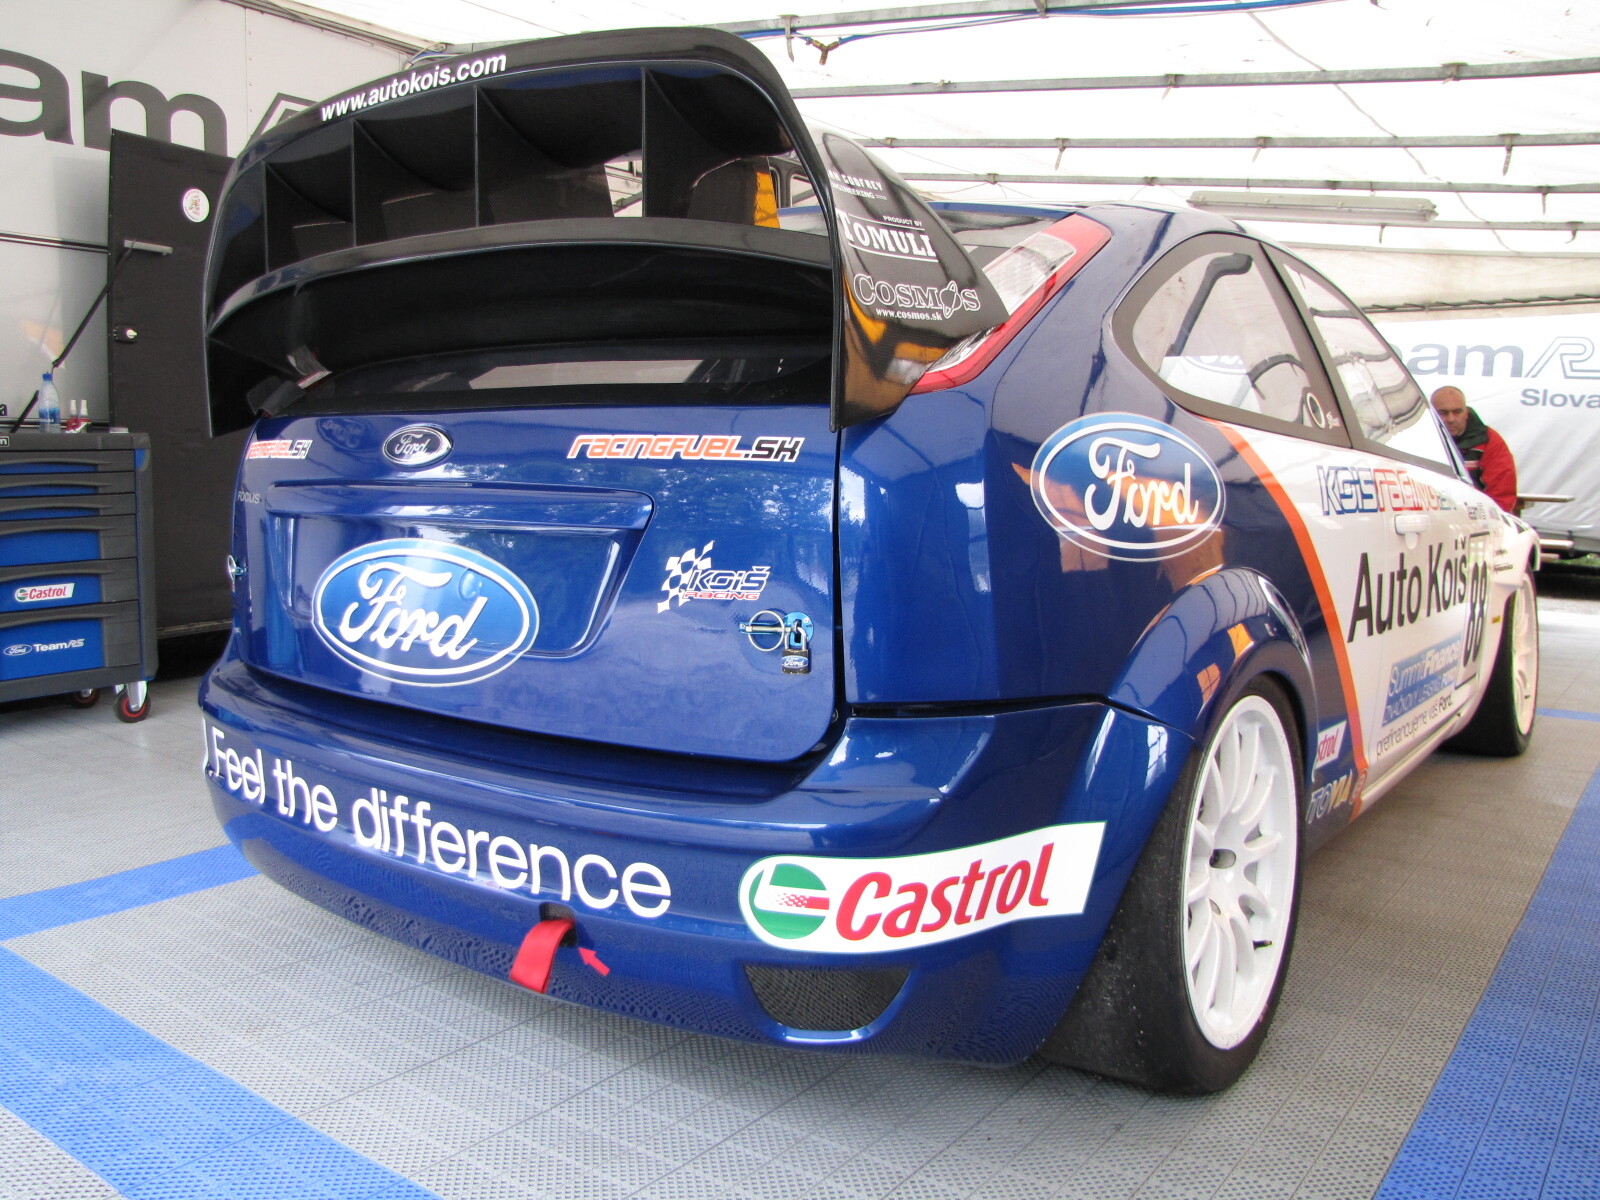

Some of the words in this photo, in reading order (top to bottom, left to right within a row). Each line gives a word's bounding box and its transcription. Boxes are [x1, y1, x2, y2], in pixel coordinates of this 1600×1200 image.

[321, 53, 507, 122] www.autokois.com
[883, 215, 913, 226] PRODUCT
[853, 273, 981, 319] COSMOS
[876, 307, 942, 321] www.cosmos.sk
[395, 433, 431, 455] Ford
[237, 491, 261, 504] FOCUS
[1084, 436, 1199, 531] Ford
[29, 586, 67, 600] Castrol
[340, 561, 488, 660] Ford
[1347, 552, 1422, 643] Auto
[1427, 536, 1467, 617] Koiš
[211, 726, 266, 804] Feel
[273, 760, 338, 832] the
[351, 788, 672, 918] difference
[836, 842, 1055, 941] Castrol
